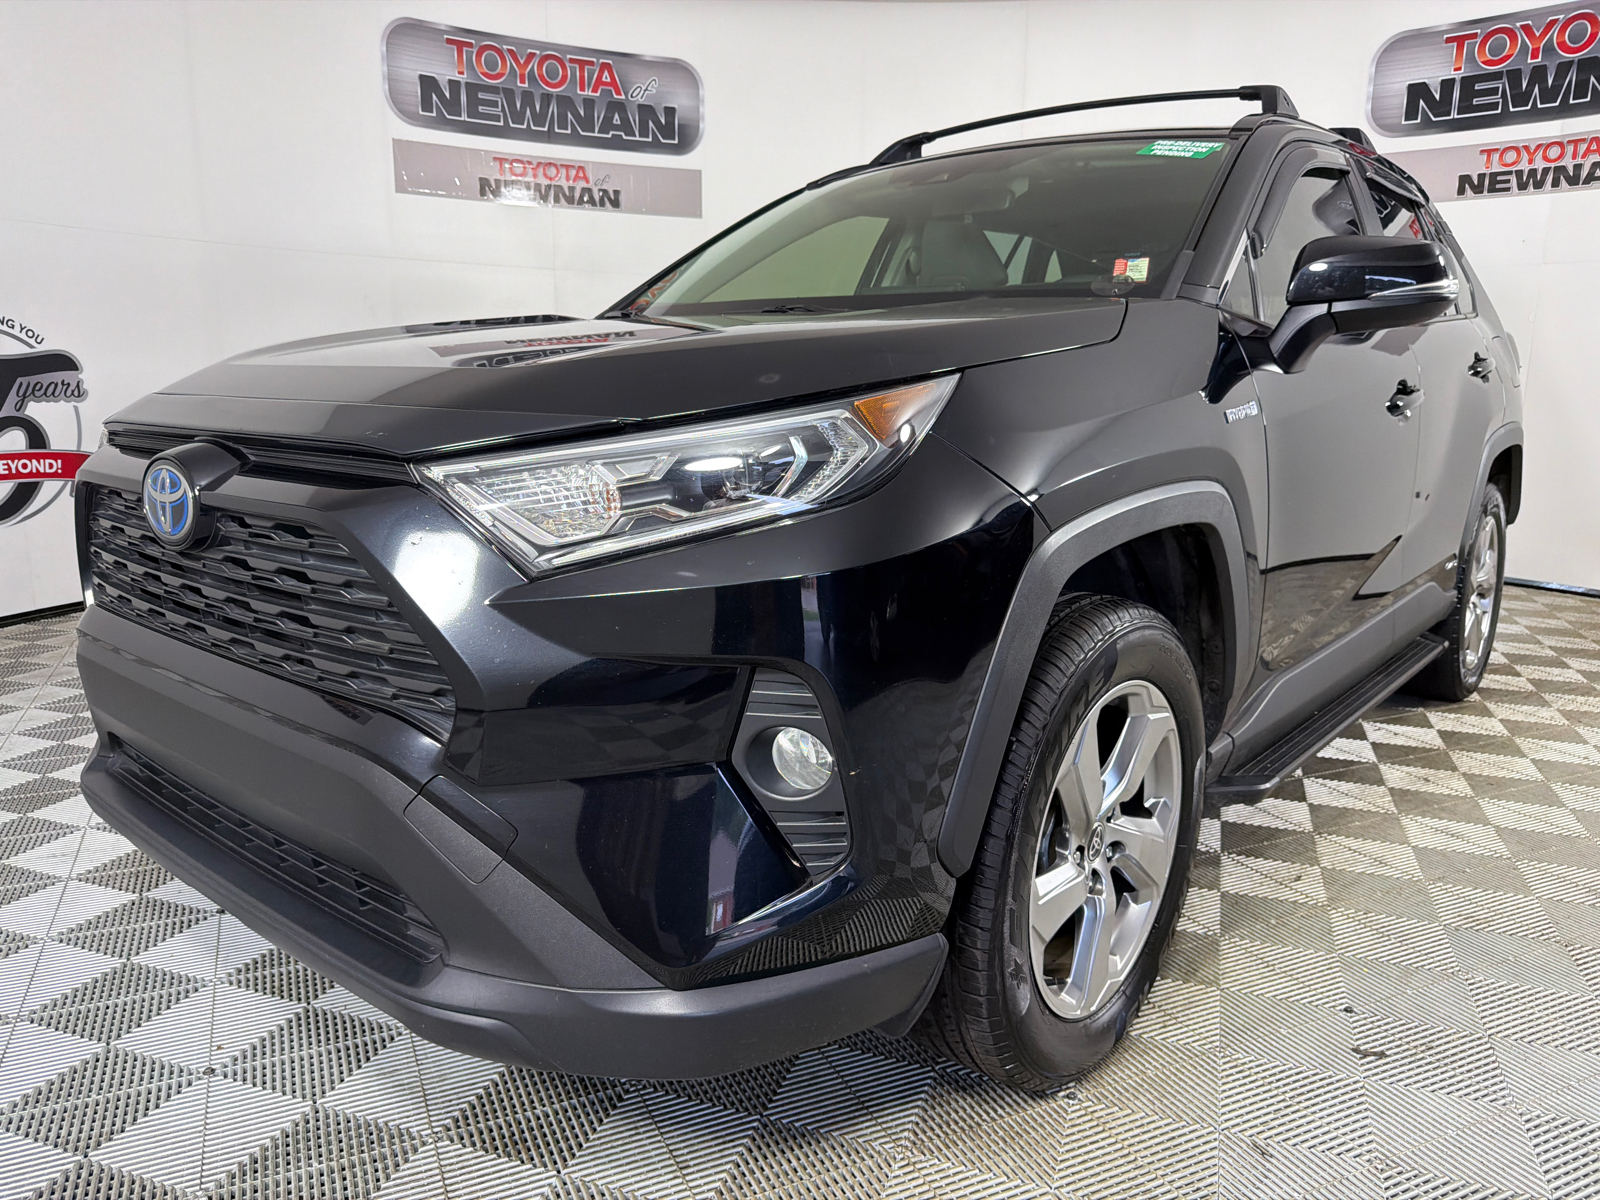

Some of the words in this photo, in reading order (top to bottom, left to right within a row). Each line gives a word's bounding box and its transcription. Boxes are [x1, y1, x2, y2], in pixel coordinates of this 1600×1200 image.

[1444, 9, 1600, 74] TOYO
[444, 35, 625, 99] TOYOTA
[628, 77, 658, 101] of
[418, 73, 678, 143] NEWNAN
[1150, 145, 1210, 153] INSPECTION
[1479, 135, 1600, 170] TOYOTA
[493, 156, 591, 184] TOYOTA
[594, 174, 610, 187] of
[478, 177, 622, 209] NWNAN
[19, 323, 45, 345] YOU
[14, 379, 85, 412] years
[0, 459, 62, 474] EYOND!
